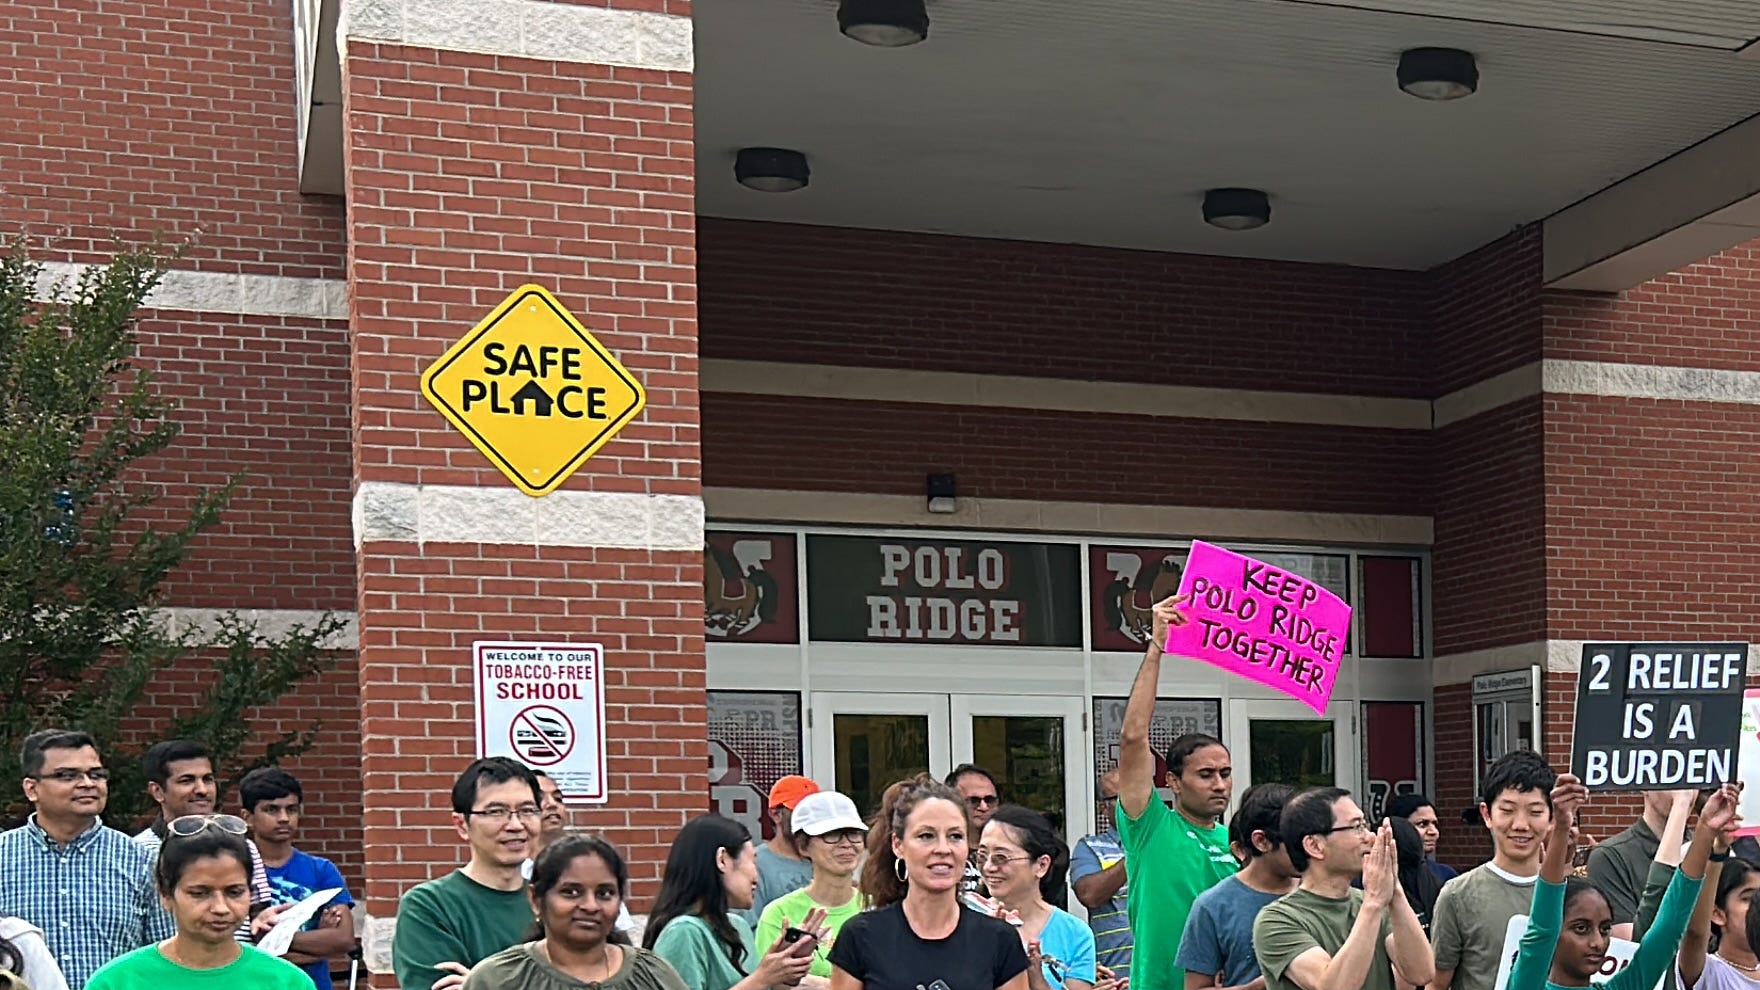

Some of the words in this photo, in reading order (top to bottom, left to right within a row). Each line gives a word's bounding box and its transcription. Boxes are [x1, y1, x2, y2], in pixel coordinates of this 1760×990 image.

[483, 342, 581, 381] SAFE
[880, 544, 1004, 590] POLO
[1243, 559, 1317, 610] KEEP
[866, 595, 1020, 641] RIDGE
[1188, 577, 1257, 621] POLO
[1269, 605, 1337, 663] RIDGE
[485, 652, 544, 662] WELCOME
[548, 653, 564, 662] TO
[566, 653, 592, 662] OUR
[485, 663, 593, 681] TOBACCO-FREE
[1198, 617, 1325, 695] TOGETHER
[1588, 653, 1612, 691] 2
[1628, 652, 1741, 690] RELIEF
[496, 682, 584, 701] SCHOOL
[1622, 702, 1655, 740] IS
[1668, 703, 1696, 740] A
[1585, 747, 1731, 786] BURDEN
